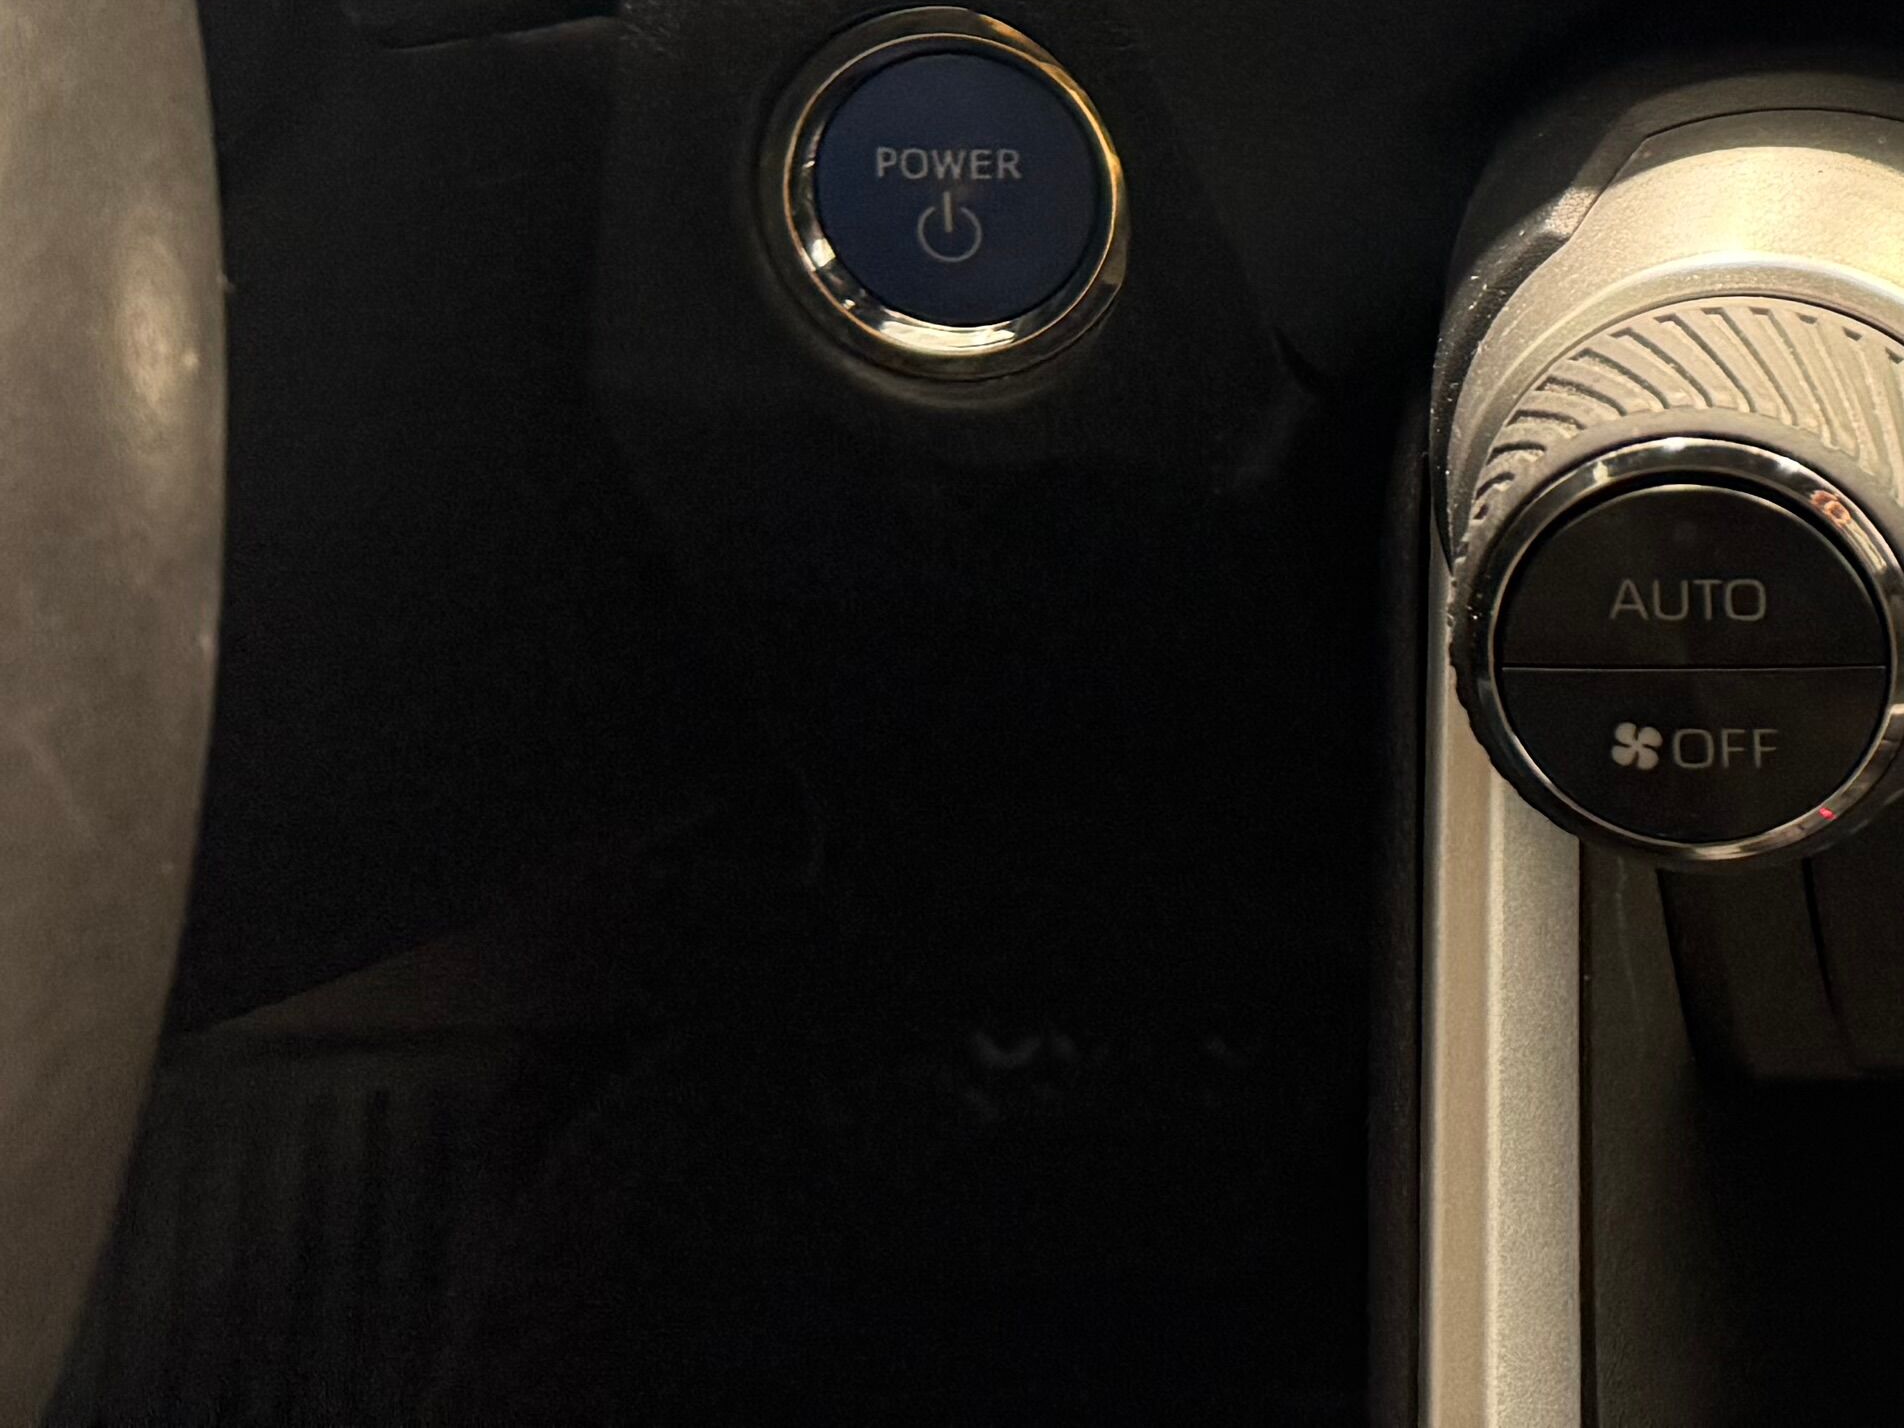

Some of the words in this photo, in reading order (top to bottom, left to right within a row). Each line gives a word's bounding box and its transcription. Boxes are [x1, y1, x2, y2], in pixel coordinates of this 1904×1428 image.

[875, 149, 1021, 181] POWER
[1610, 578, 1767, 622] AUTO
[1671, 727, 1779, 770] OFF
